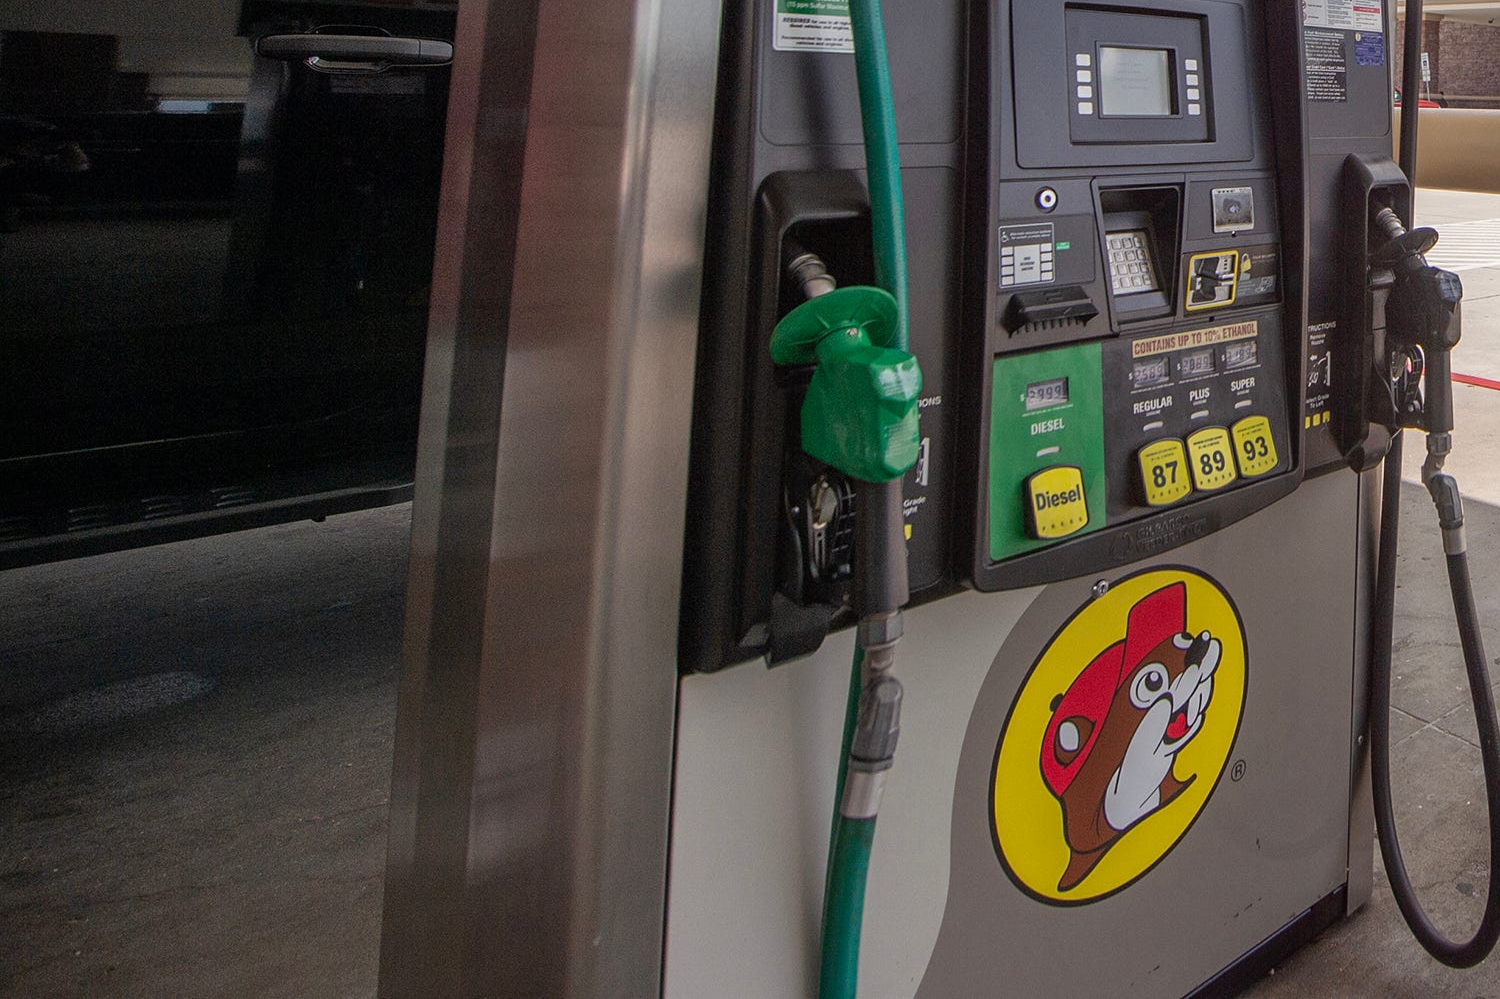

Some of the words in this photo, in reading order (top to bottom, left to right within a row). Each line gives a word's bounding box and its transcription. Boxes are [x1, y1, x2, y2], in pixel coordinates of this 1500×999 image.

[1134, 339, 1176, 355] CONTAINS
[1178, 336, 1188, 347] UP
[1192, 333, 1202, 343] TO
[1205, 330, 1221, 342] 10%
[1222, 323, 1256, 339] ETHANOL
[1189, 387, 1210, 402] PLUS
[1231, 377, 1255, 392] SUPER
[1133, 396, 1173, 415] REGULAR
[1030, 417, 1065, 436] DIESEL
[1243, 436, 1269, 461] 93
[1152, 460, 1178, 488] 87
[1200, 450, 1226, 476] 89
[1035, 484, 1082, 511] Diesel
